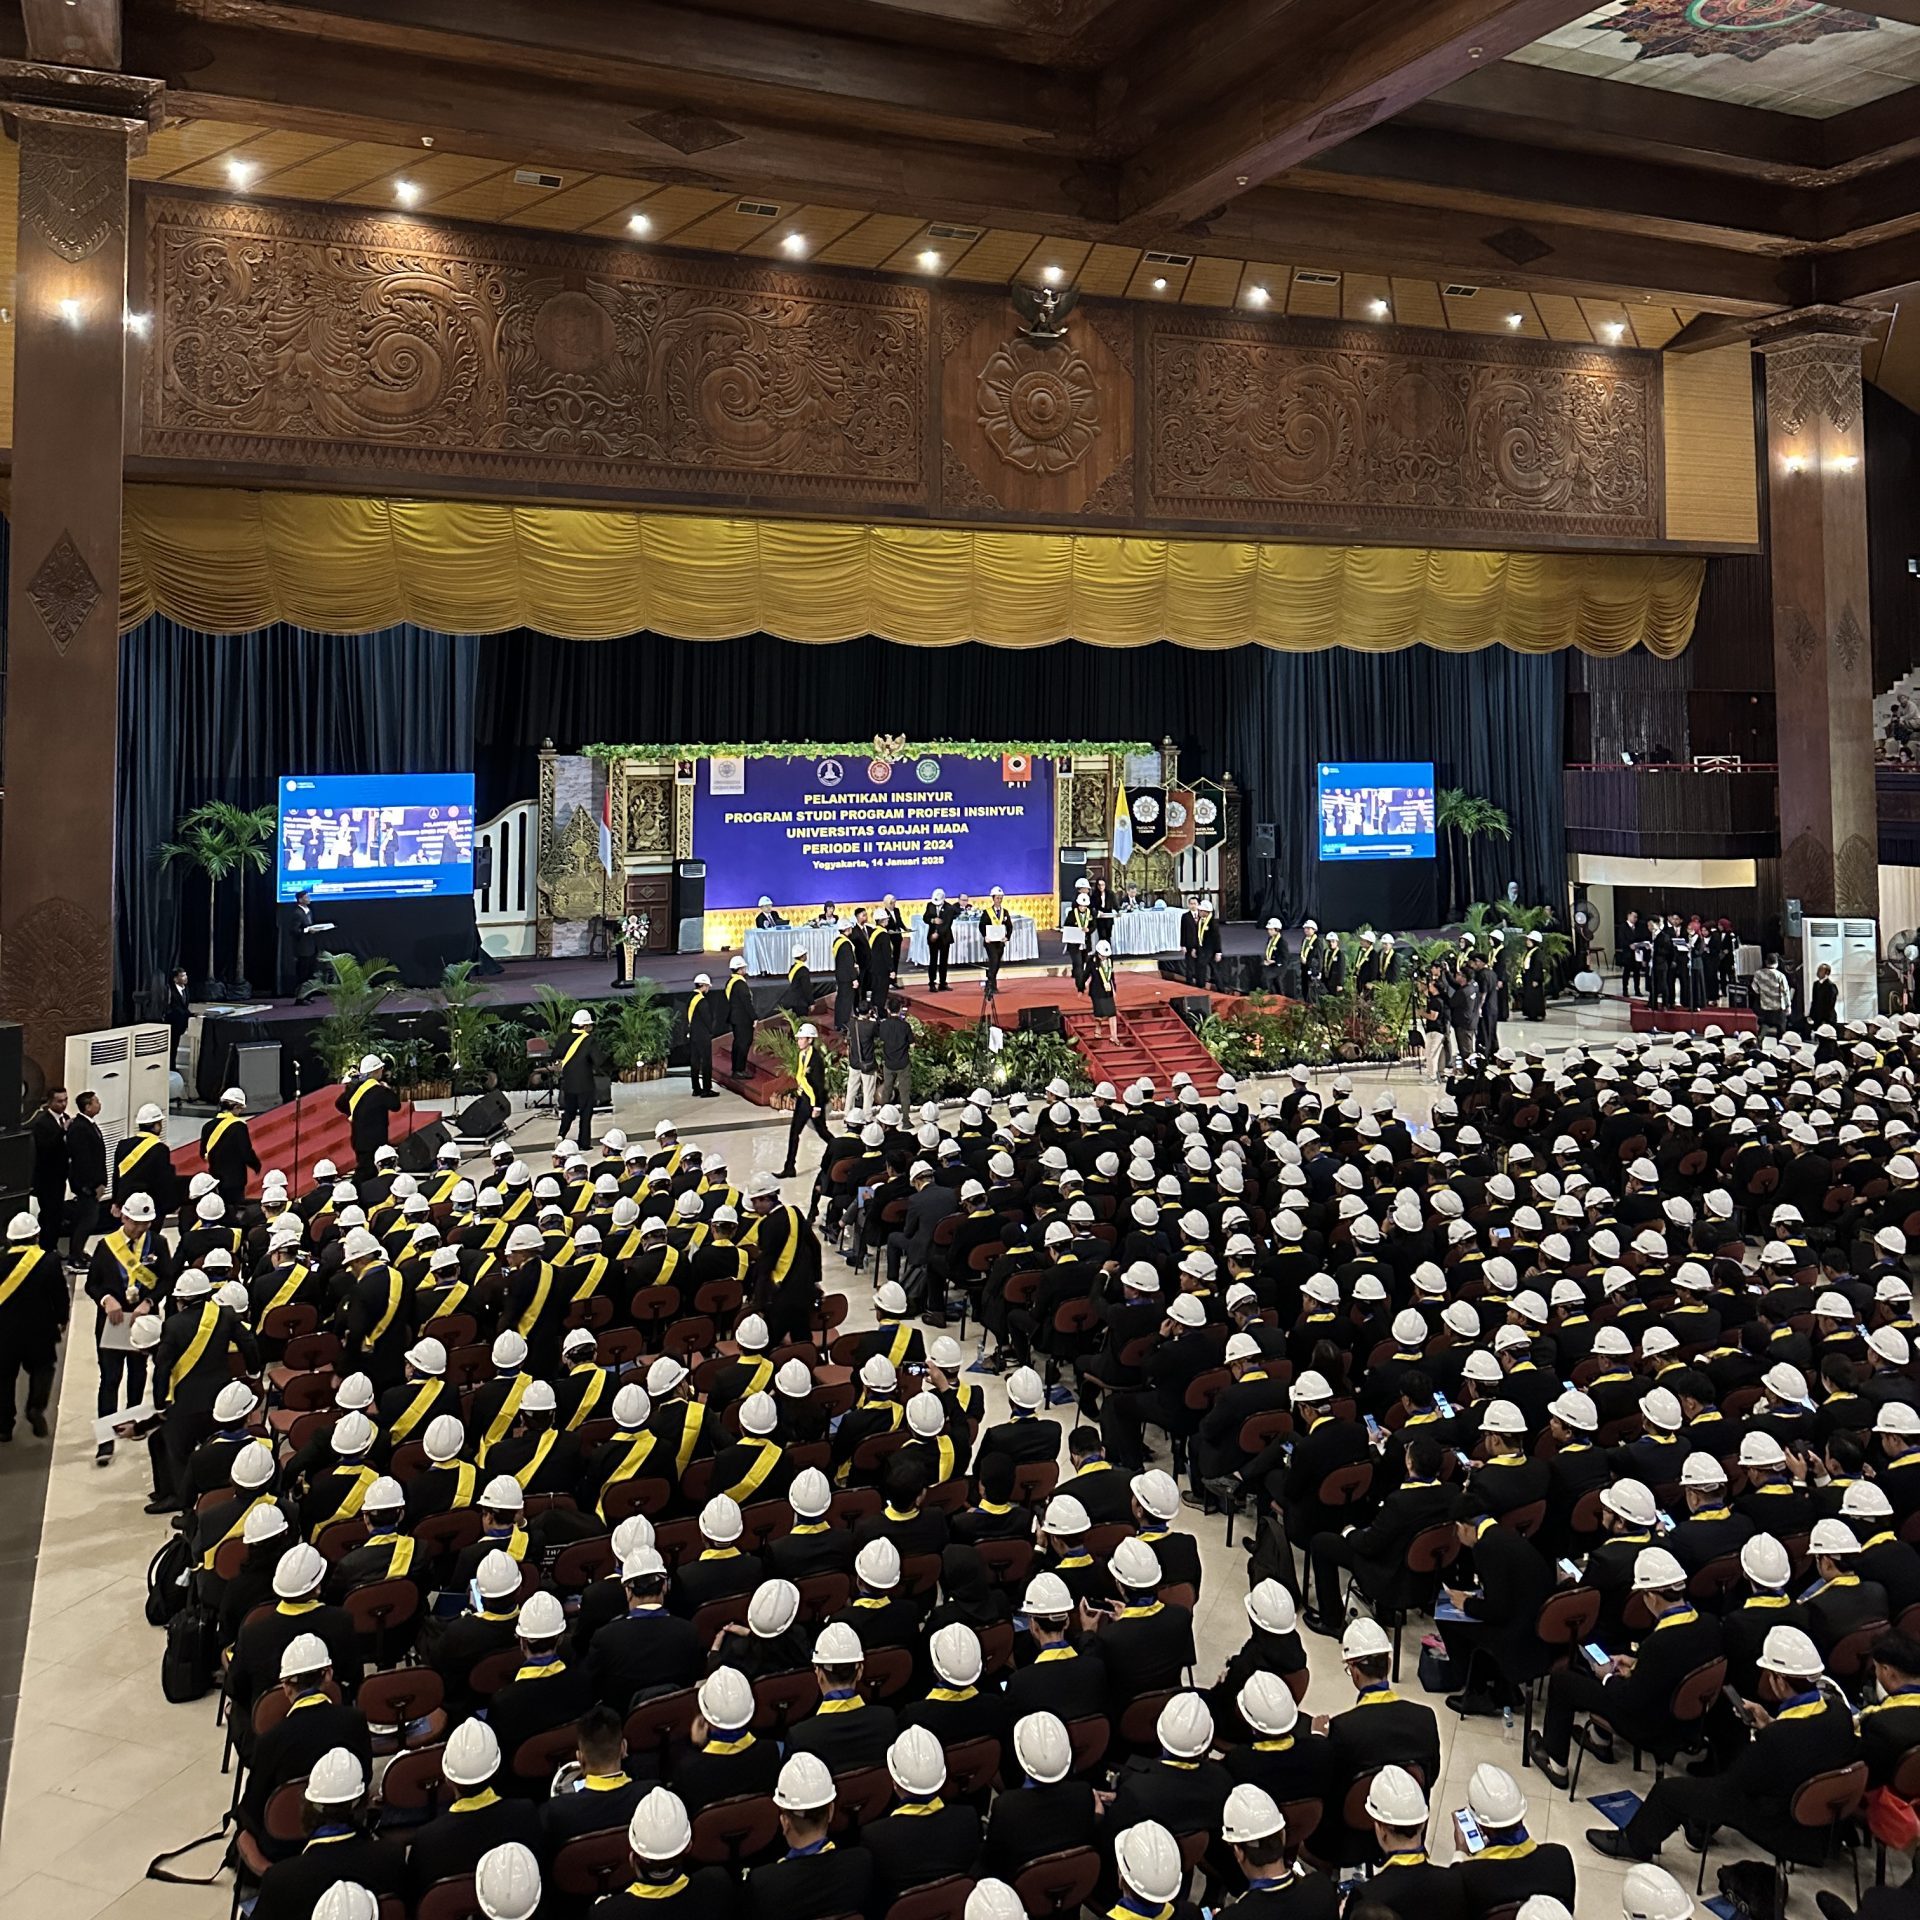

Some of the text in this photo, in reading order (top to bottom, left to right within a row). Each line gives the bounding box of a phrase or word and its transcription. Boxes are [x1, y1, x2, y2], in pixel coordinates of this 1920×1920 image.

[1008, 781, 1026, 789] PII
[804, 792, 953, 805] PELANTIKAN INSINYUR
[724, 806, 1024, 823] PROGRAM STUDI PROGRAM PROFESI INSINYUR
[786, 823, 969, 838] UNIVERSITAS GADJAH MADA
[802, 839, 954, 855] PERIODE II TAHUN 2024
[812, 856, 945, 871] Yogyakarta, 14 Januari 2025
